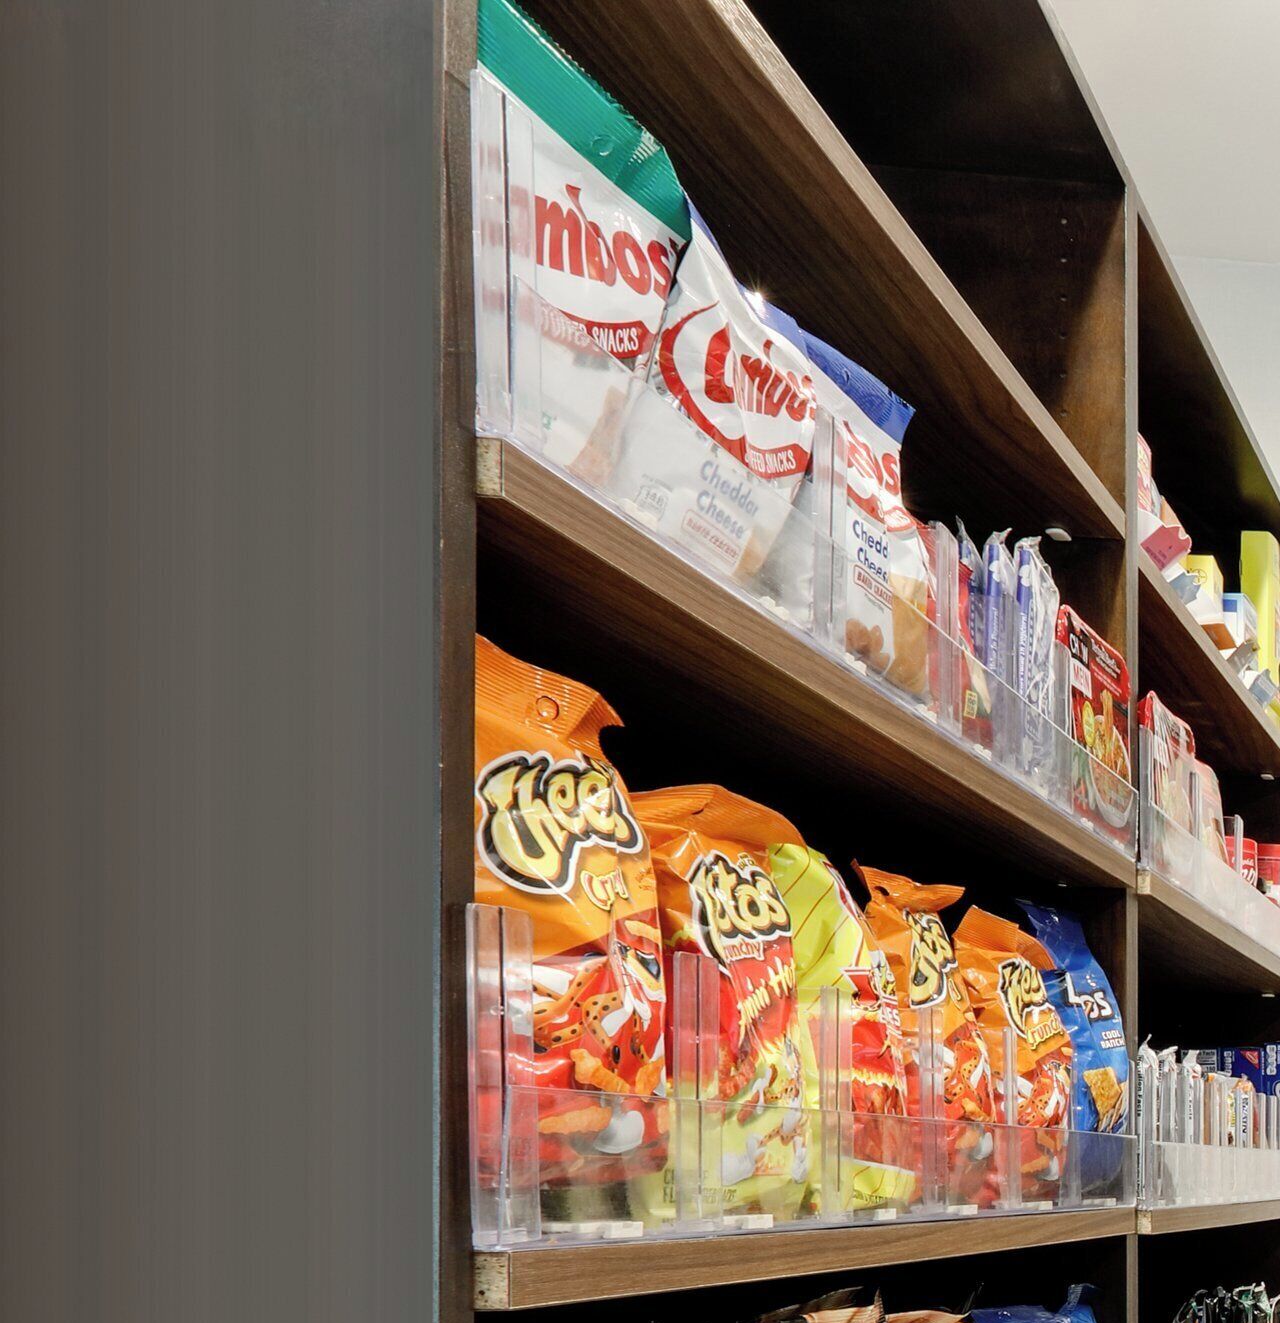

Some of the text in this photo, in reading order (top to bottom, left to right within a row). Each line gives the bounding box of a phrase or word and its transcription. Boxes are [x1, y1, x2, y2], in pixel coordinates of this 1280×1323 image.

[534, 183, 678, 301] mbos
[591, 326, 639, 352] SNACKS
[700, 460, 760, 518] Cheddar
[696, 491, 747, 541] Cheese
[852, 519, 889, 560] Chedd
[873, 580, 893, 606] CRACKE
[1100, 1039, 1125, 1049] RANCH
[1101, 1030, 1122, 1040] COOL
